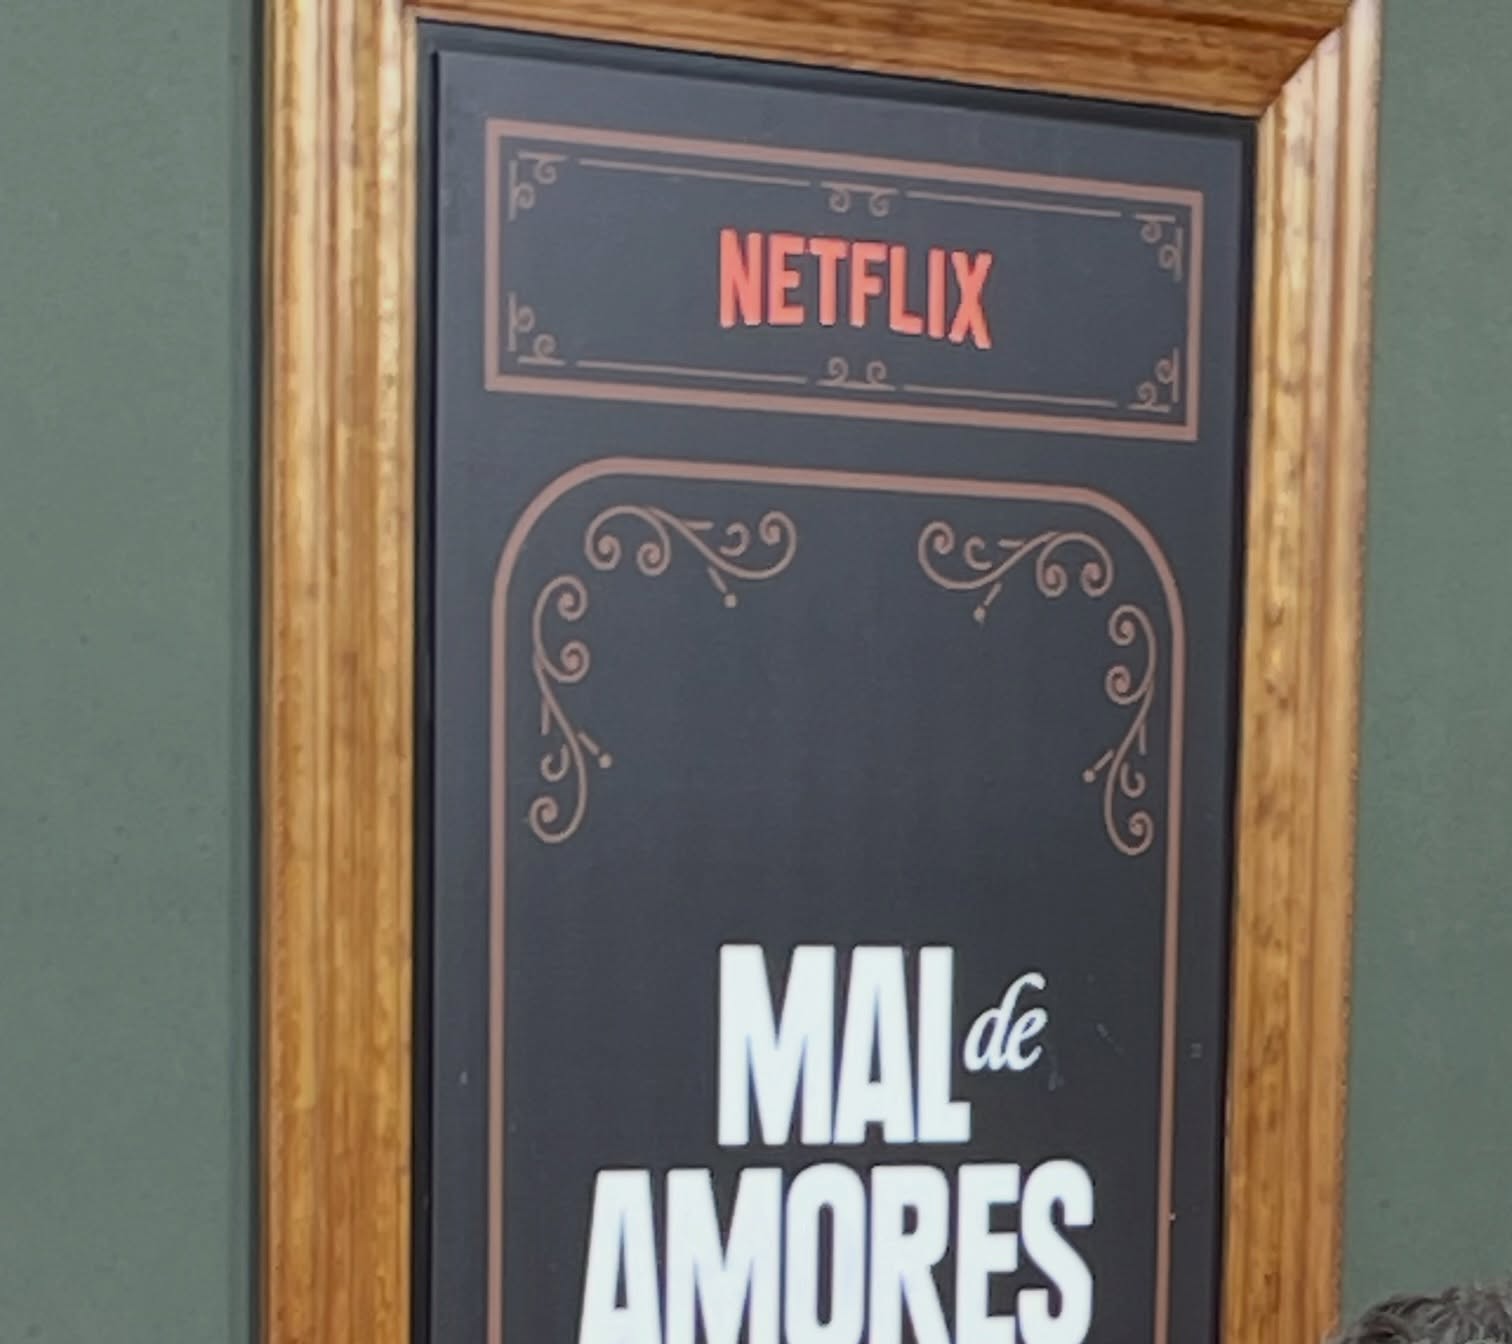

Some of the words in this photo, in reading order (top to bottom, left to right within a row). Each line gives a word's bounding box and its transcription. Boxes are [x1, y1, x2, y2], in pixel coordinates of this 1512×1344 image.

[719, 230, 992, 348] NETFLIX
[717, 944, 971, 1146] MAL
[963, 972, 1048, 1072] de
